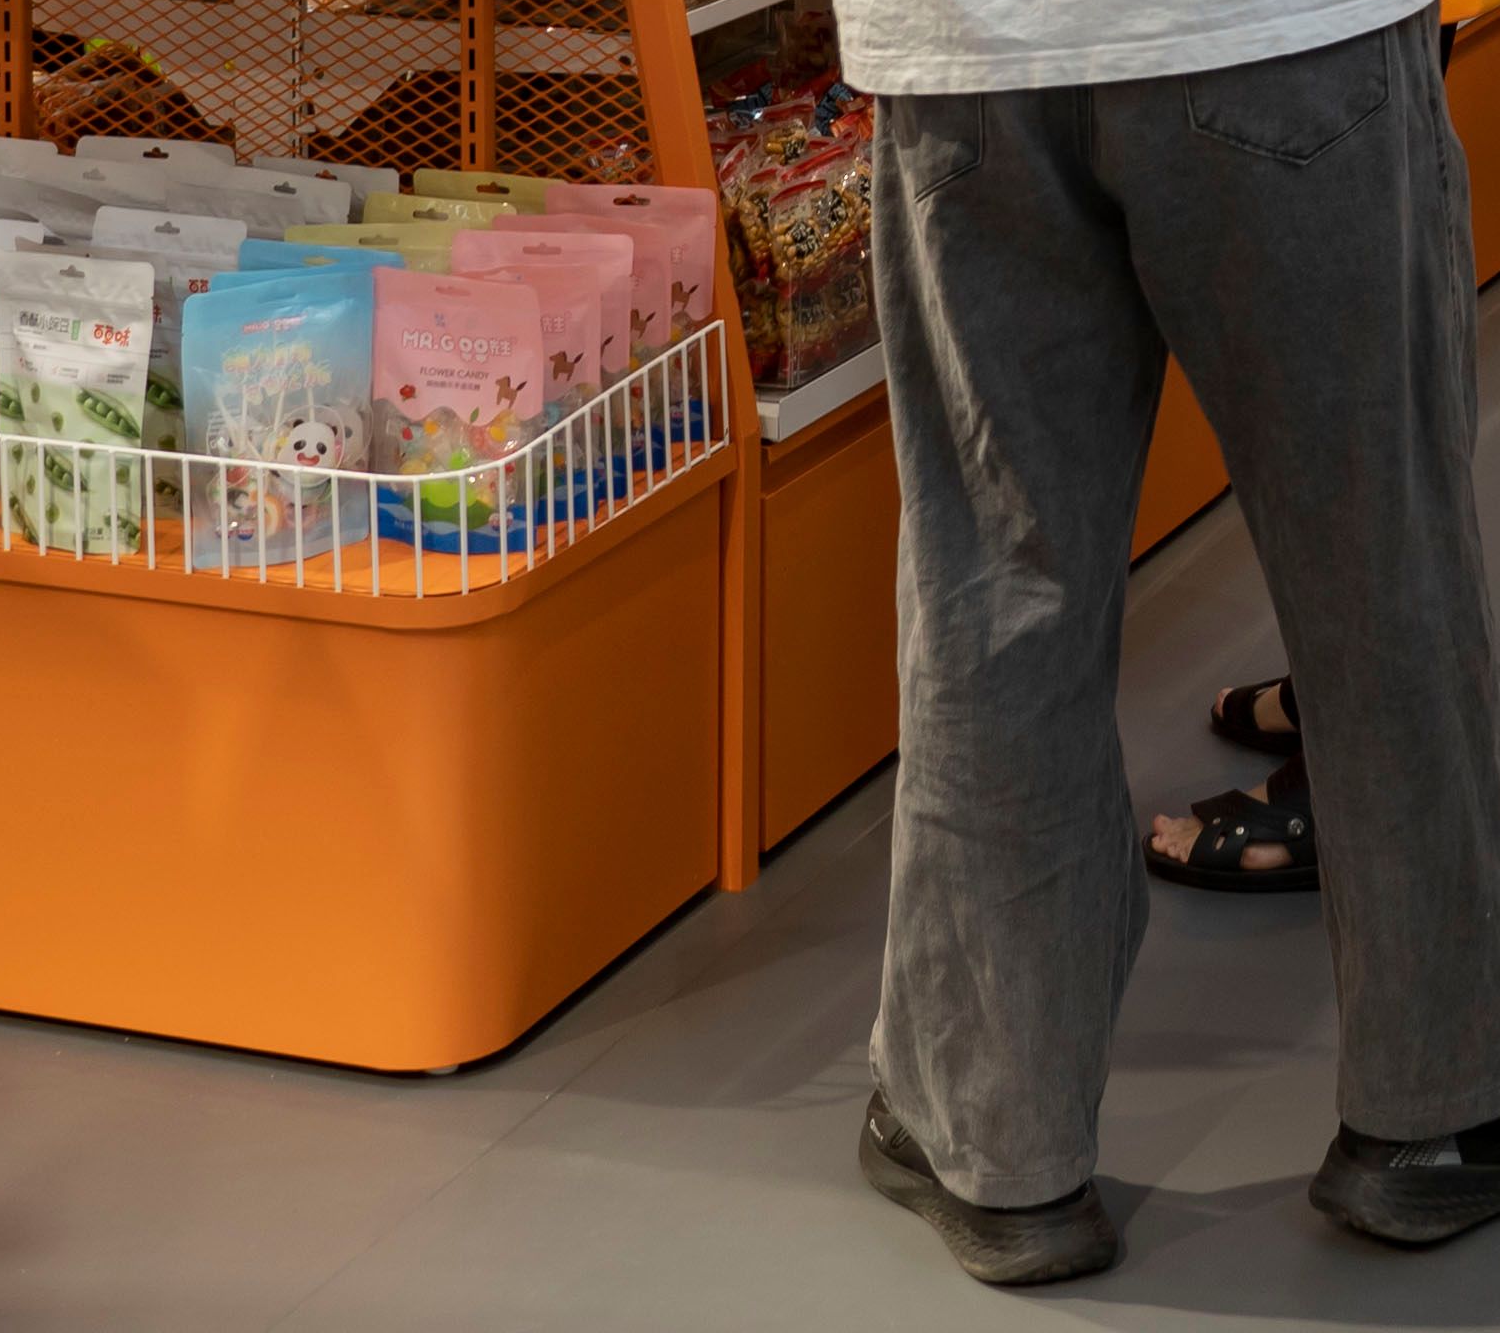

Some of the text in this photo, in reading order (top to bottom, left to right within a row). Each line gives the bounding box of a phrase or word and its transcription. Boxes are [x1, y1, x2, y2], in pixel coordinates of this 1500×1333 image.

[93, 324, 132, 346] 百草味
[419, 366, 489, 381] FLOWER CANDY
